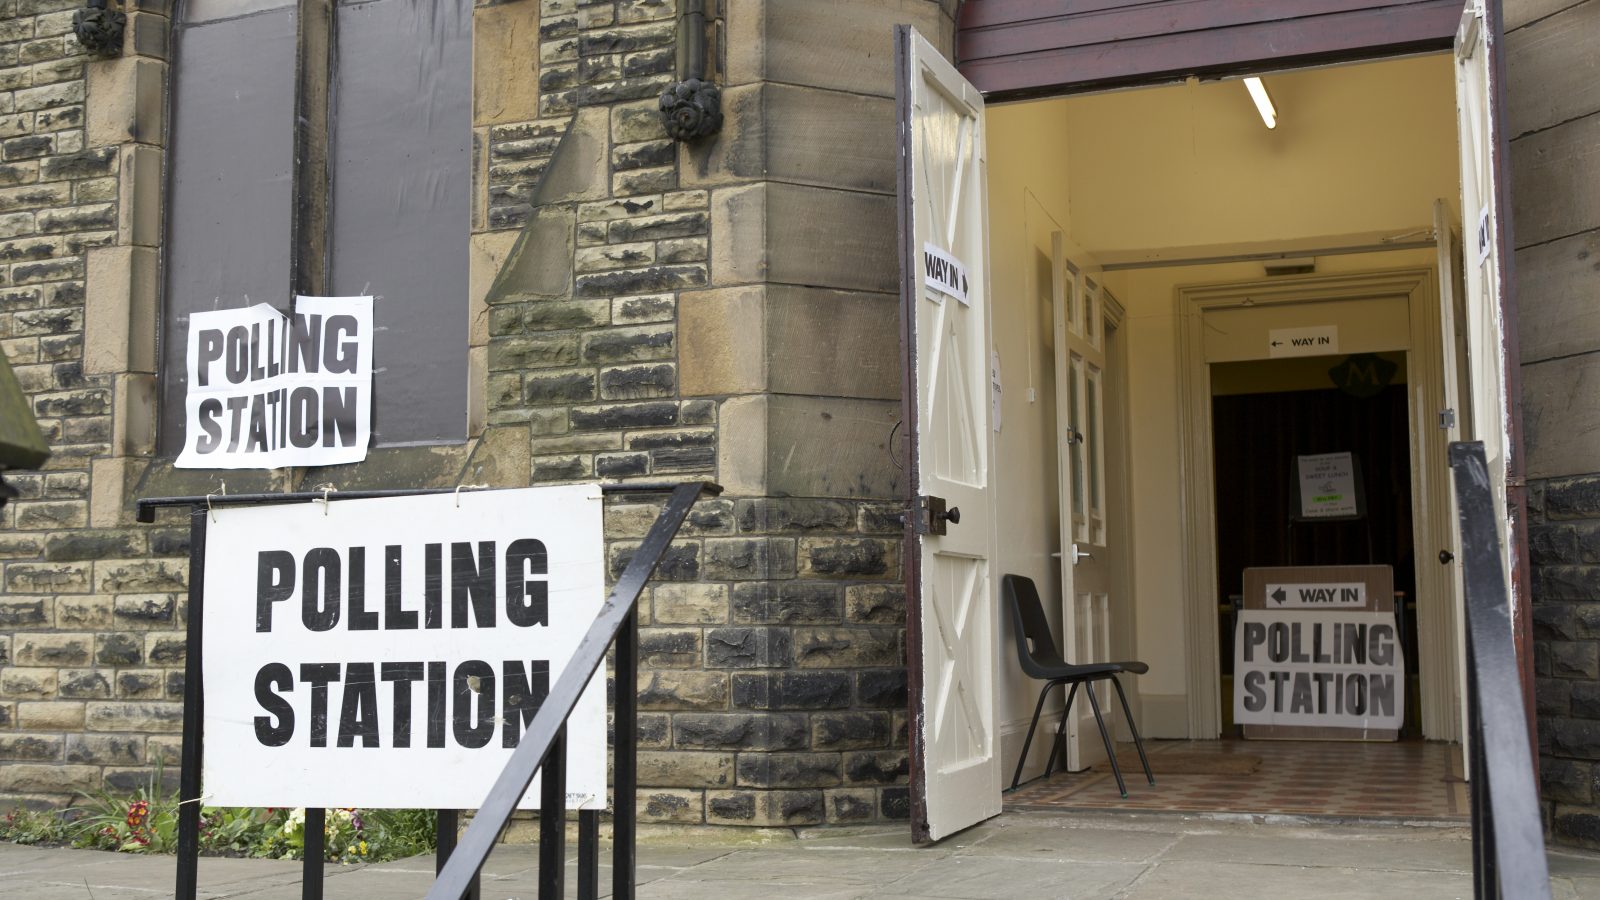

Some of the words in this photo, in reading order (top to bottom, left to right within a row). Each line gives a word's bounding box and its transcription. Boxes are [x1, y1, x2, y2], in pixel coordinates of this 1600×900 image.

[924, 251, 948, 284] WAY
[949, 263, 959, 290] IN
[197, 313, 359, 387] POLLING
[1291, 337, 1314, 347] WAY
[1317, 336, 1330, 345] IN
[1347, 362, 1379, 385] M
[196, 386, 357, 454] STATION
[256, 538, 549, 633] POLLING
[1299, 588, 1336, 602] WAY
[1340, 588, 1359, 602] IN
[1243, 621, 1395, 667] POLLING
[254, 660, 550, 749] STATION
[1243, 670, 1395, 717] STATION
